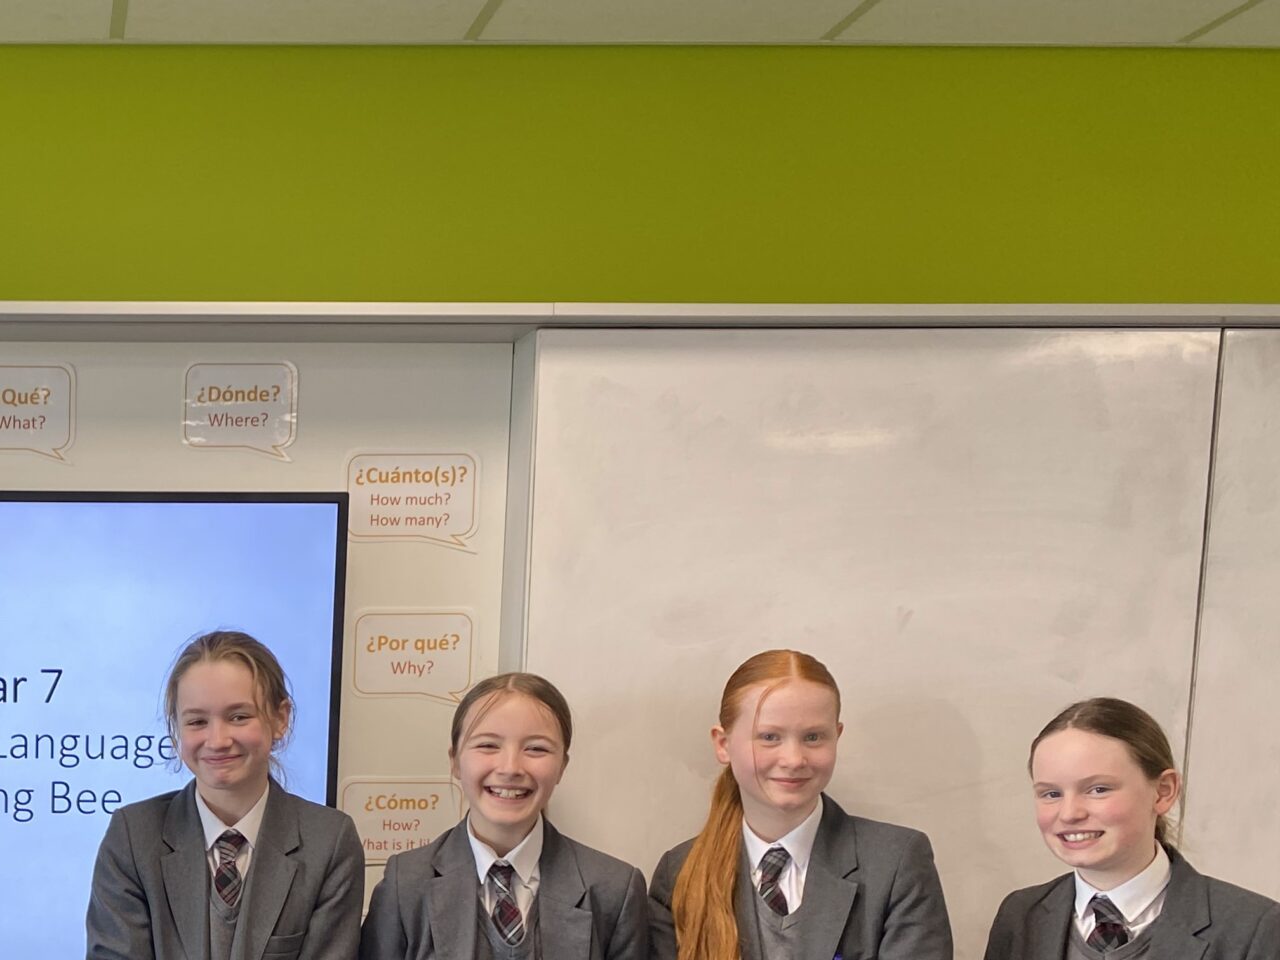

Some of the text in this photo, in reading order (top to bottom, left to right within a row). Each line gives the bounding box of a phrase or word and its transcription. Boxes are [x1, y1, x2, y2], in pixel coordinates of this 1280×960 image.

[196, 385, 281, 403] ¿Dónde?
[208, 413, 269, 428] Where?
[355, 466, 468, 487] ¿Cuánto(s)?
[370, 492, 451, 506] How much?
[370, 513, 450, 529] How many?
[366, 634, 460, 654] ¿Por qué?
[391, 660, 434, 678] Why?
[40, 668, 64, 703] 7
[51, 780, 122, 815] Bee
[364, 793, 440, 812] ¿Cómo?
[382, 818, 421, 832] How?
[363, 838, 388, 851] hat
[392, 838, 402, 851] is
[406, 838, 415, 850] it
